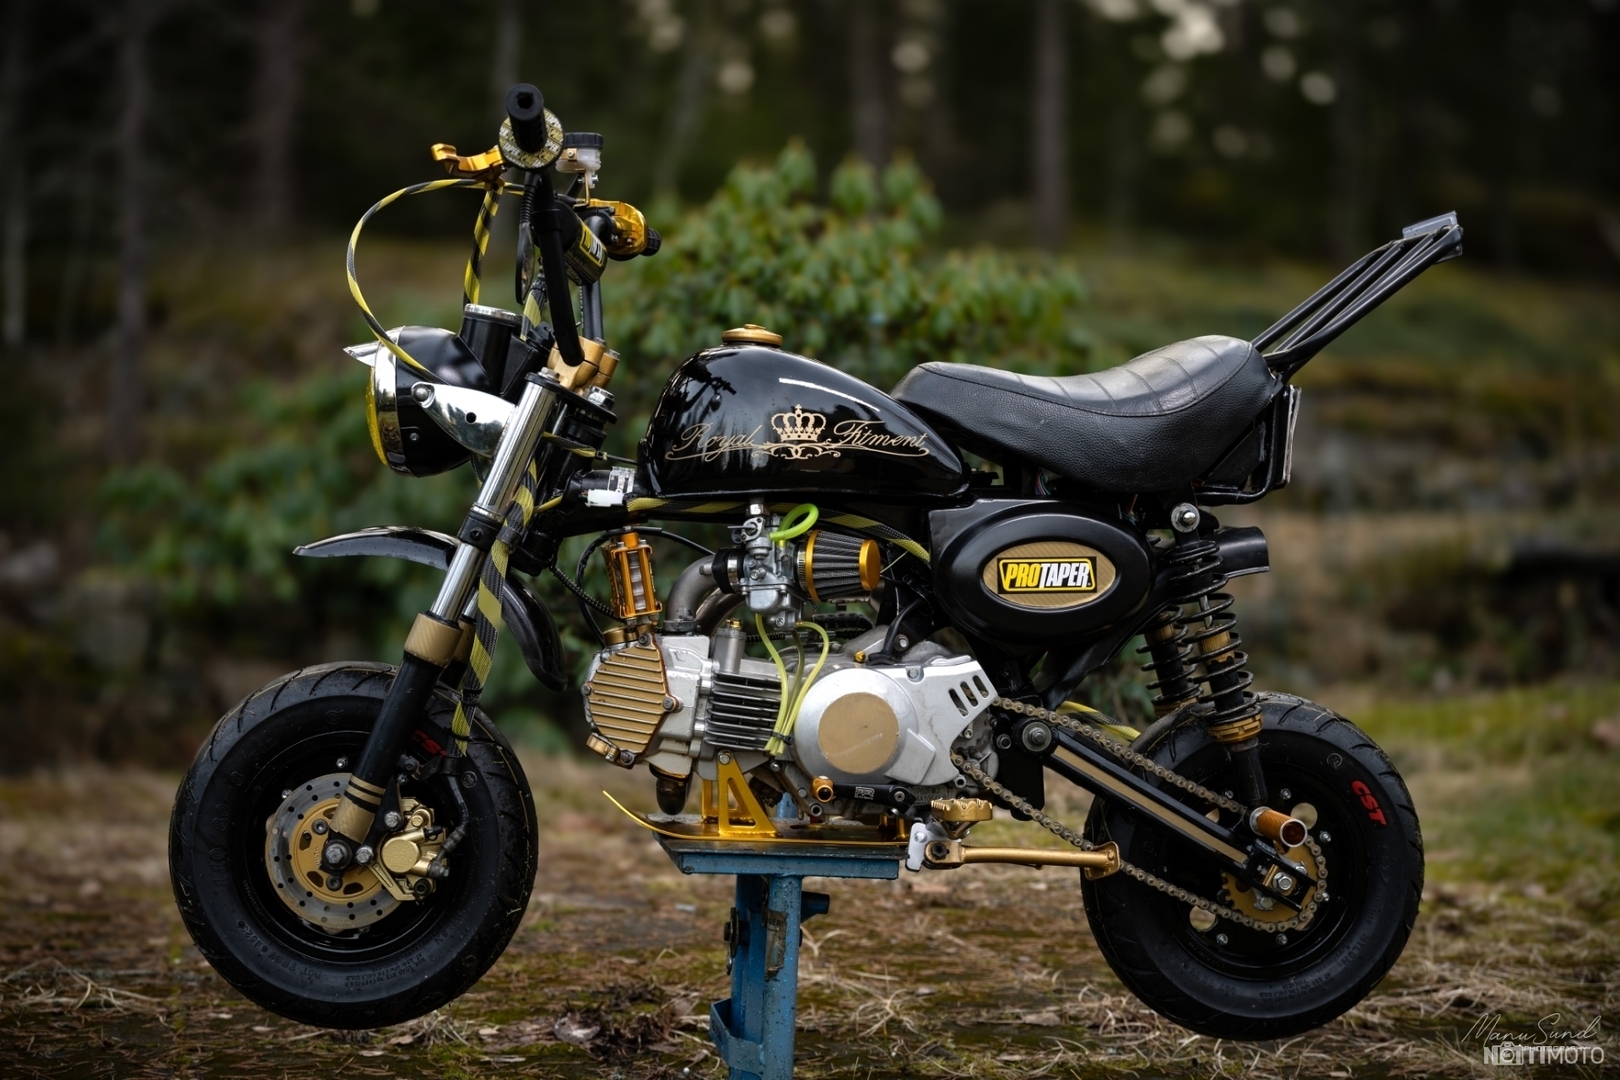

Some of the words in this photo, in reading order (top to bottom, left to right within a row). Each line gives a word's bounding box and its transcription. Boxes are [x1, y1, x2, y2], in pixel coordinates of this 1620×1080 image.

[672, 422, 763, 462] Royal
[833, 419, 928, 448] Fitment
[1004, 562, 1091, 589] PROTAPER
[1351, 780, 1387, 825] CST
